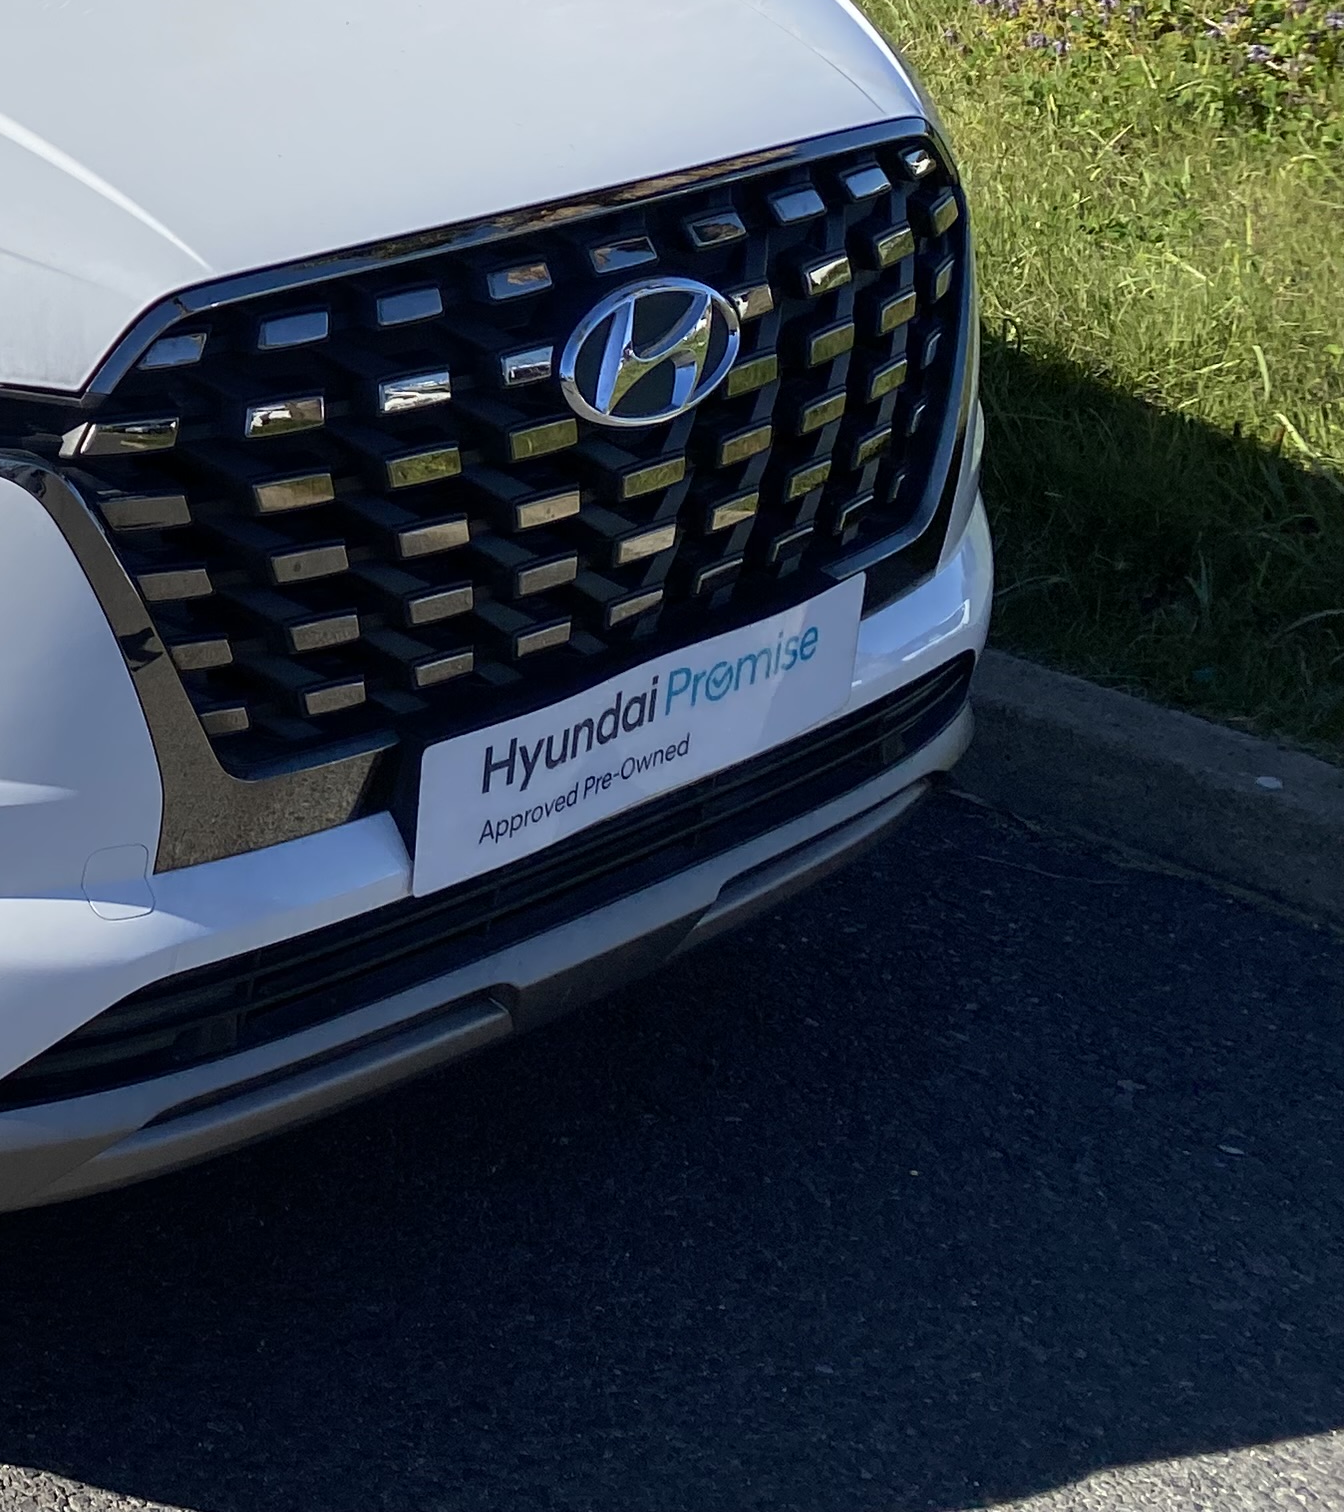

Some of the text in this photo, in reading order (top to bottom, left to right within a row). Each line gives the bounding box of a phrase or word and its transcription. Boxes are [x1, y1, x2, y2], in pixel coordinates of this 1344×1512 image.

[480, 625, 820, 794] Hyundai Promise
[478, 732, 691, 845] Approved Pre-Owned
